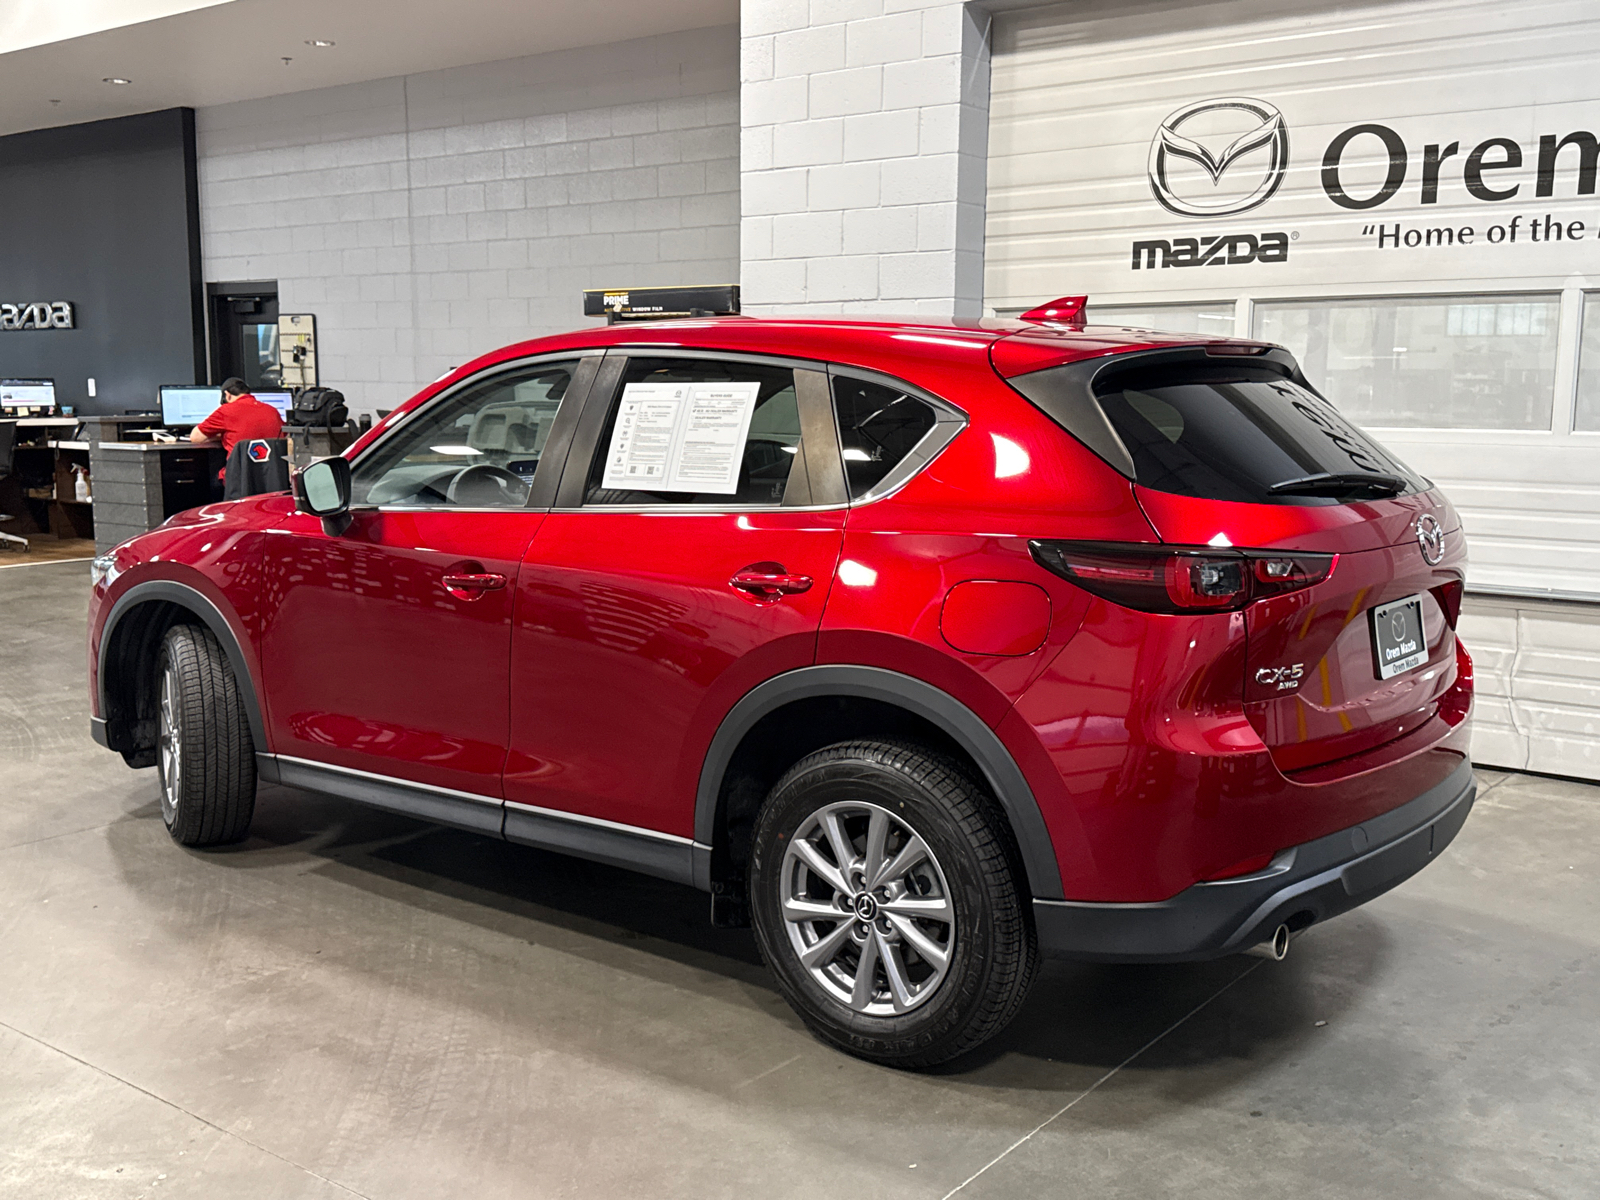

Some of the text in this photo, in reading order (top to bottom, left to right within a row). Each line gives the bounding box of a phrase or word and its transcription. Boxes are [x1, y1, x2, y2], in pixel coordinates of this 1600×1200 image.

[1320, 123, 1600, 210] Orem
[1487, 215, 1523, 243] of
[1530, 214, 1585, 242] the
[603, 295, 629, 305] PRIME
[0, 301, 73, 330] azda
[1386, 639, 1417, 660] Orem Mazda
[1255, 663, 1304, 684] CX-5
[1277, 680, 1299, 691] AWD
